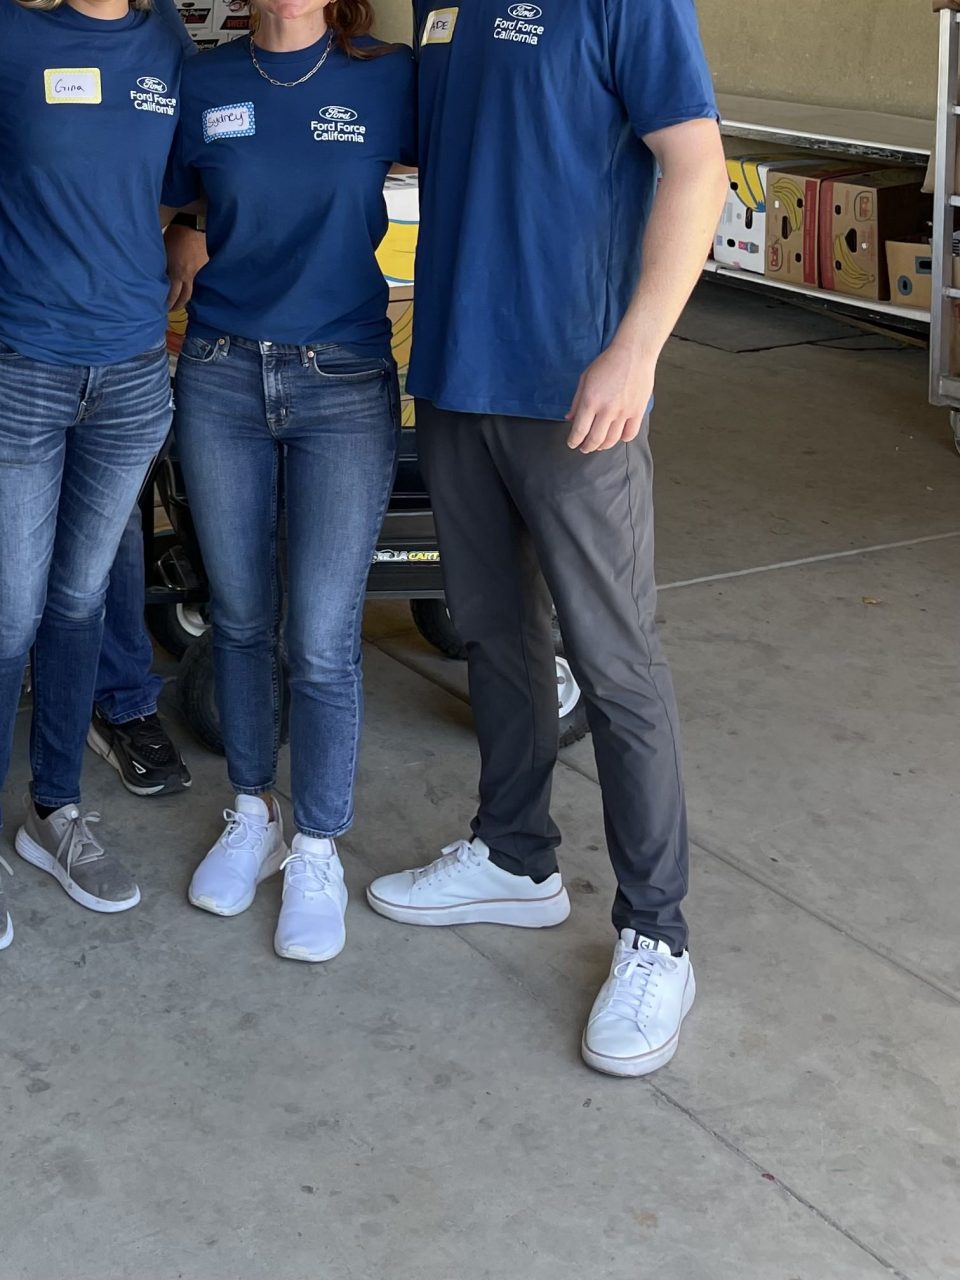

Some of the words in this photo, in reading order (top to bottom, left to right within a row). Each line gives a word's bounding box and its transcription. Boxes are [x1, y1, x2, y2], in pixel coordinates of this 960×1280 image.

[513, 4, 536, 18] Ford
[494, 18, 517, 29] Ford
[517, 20, 544, 35] Force
[493, 28, 538, 45] California
[55, 78, 85, 93] Gina
[143, 78, 163, 92] Ford
[130, 91, 153, 102] Ford
[154, 94, 177, 106] Force
[134, 100, 175, 116] California
[325, 106, 351, 120] Ford
[311, 121, 335, 131] Ford
[337, 122, 366, 133] Force
[313, 130, 364, 143] California
[408, 551, 440, 561] CART
